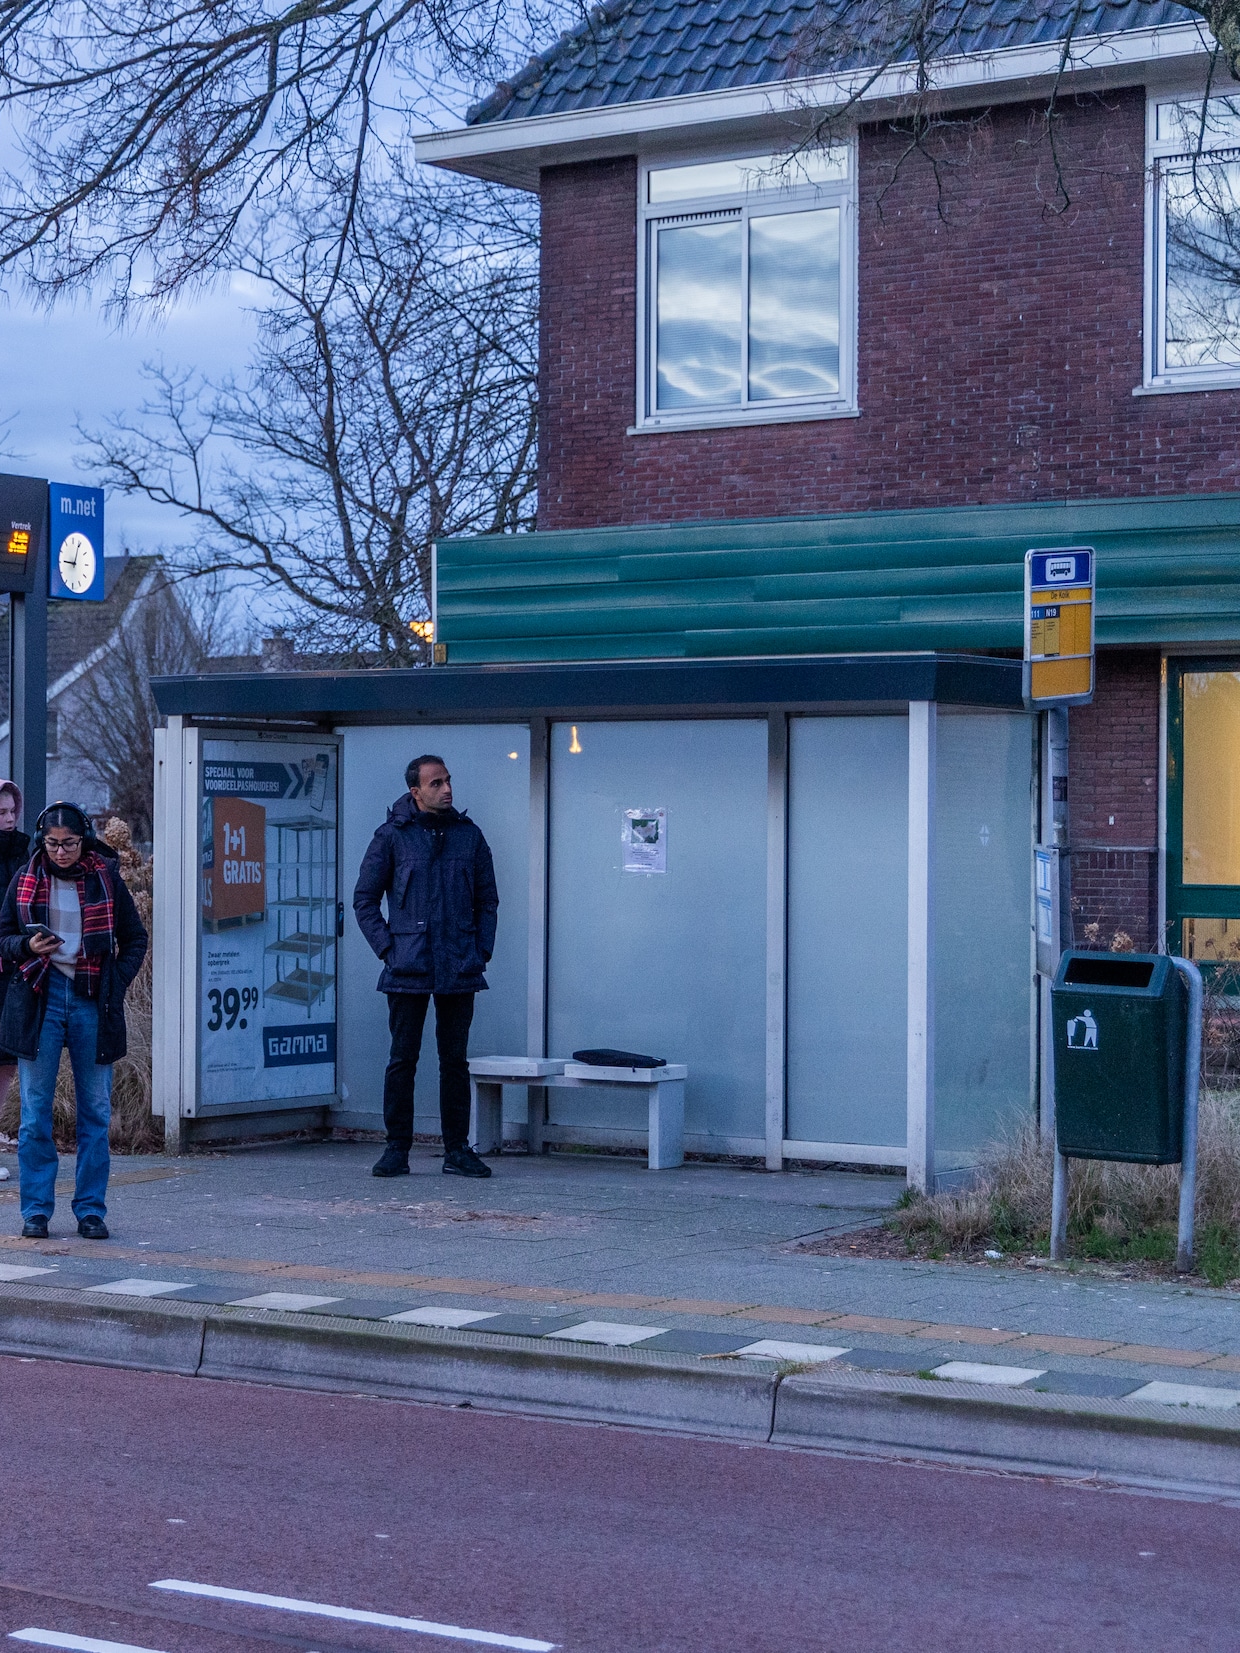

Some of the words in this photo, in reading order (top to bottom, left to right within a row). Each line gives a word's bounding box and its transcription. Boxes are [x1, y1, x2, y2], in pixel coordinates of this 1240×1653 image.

[60, 496, 96, 518] m.net
[11, 521, 31, 531] Vertrek
[1046, 608, 1056, 617] N19
[204, 766, 235, 778] SPECIAAL
[237, 767, 255, 779] VOOR
[204, 779, 280, 793] VOORDEELPASHOUDERS!
[223, 822, 246, 857] 1+1
